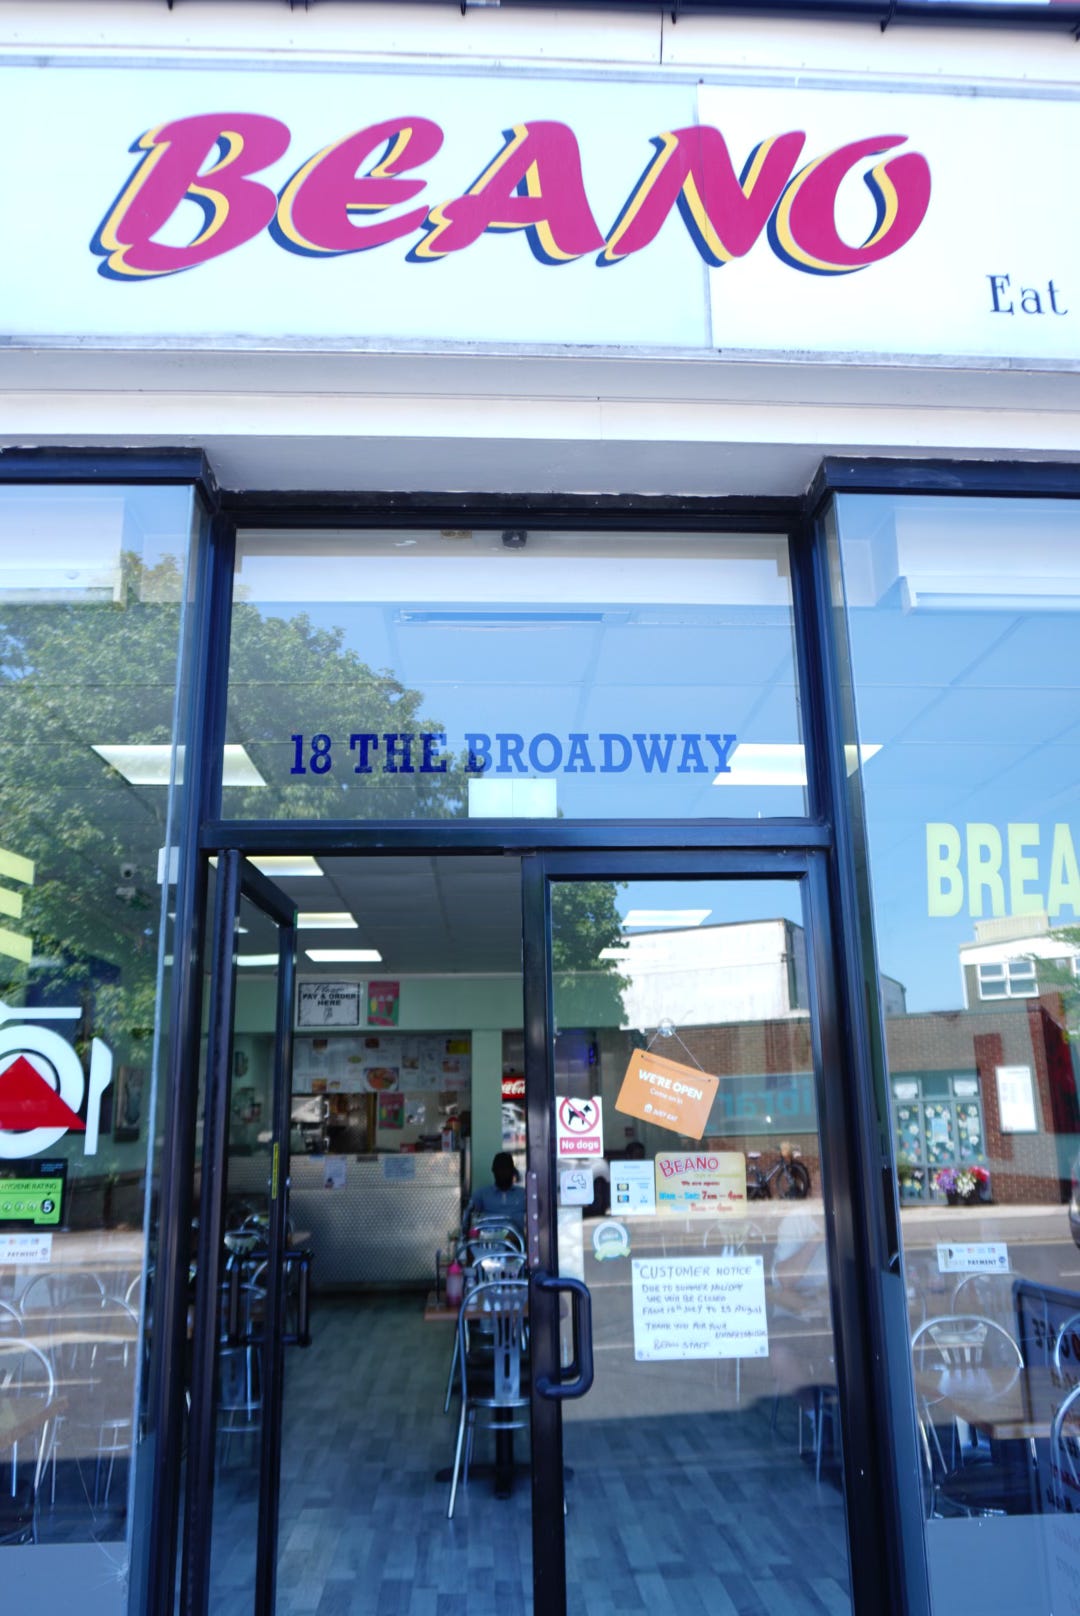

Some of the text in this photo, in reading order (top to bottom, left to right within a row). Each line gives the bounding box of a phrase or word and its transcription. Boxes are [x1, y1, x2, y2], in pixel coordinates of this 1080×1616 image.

[89, 112, 932, 281] BEANO
[985, 273, 1069, 316] Eat
[290, 732, 737, 775] 18 THE BROADWAY
[926, 822, 1080, 918] BREA
[328, 992, 356, 1000] ORDER
[638, 1069, 704, 1102] WE'RE OPEN
[649, 1087, 668, 1100] Come
[561, 1139, 600, 1152] No dogs
[659, 1156, 719, 1178] BEANO
[42, 1199, 52, 1213] 5
[967, 1258, 997, 1266] PAYMENT
[639, 1264, 752, 1280] CUSTOMER NOTICE
